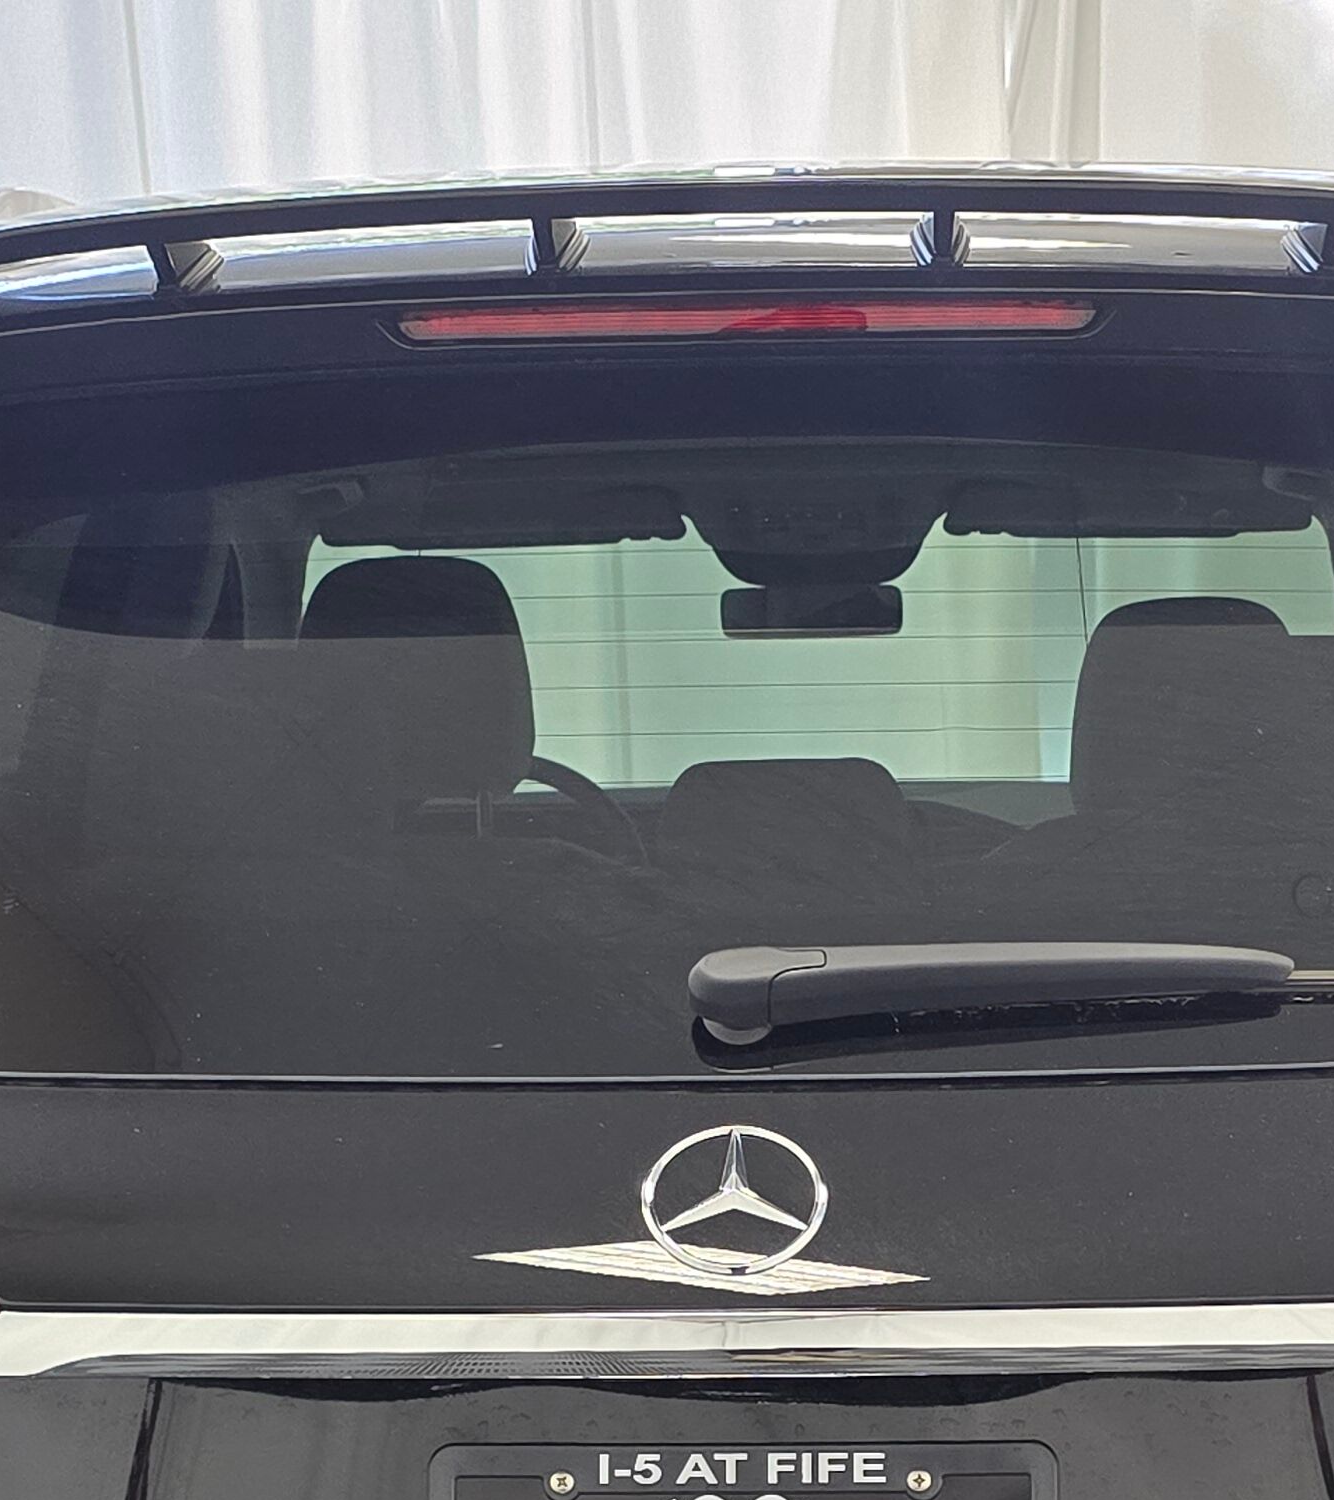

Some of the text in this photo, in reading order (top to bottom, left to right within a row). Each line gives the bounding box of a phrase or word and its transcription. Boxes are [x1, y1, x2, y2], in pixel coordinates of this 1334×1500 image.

[599, 1452, 887, 1485] I-5 AT FIFE
